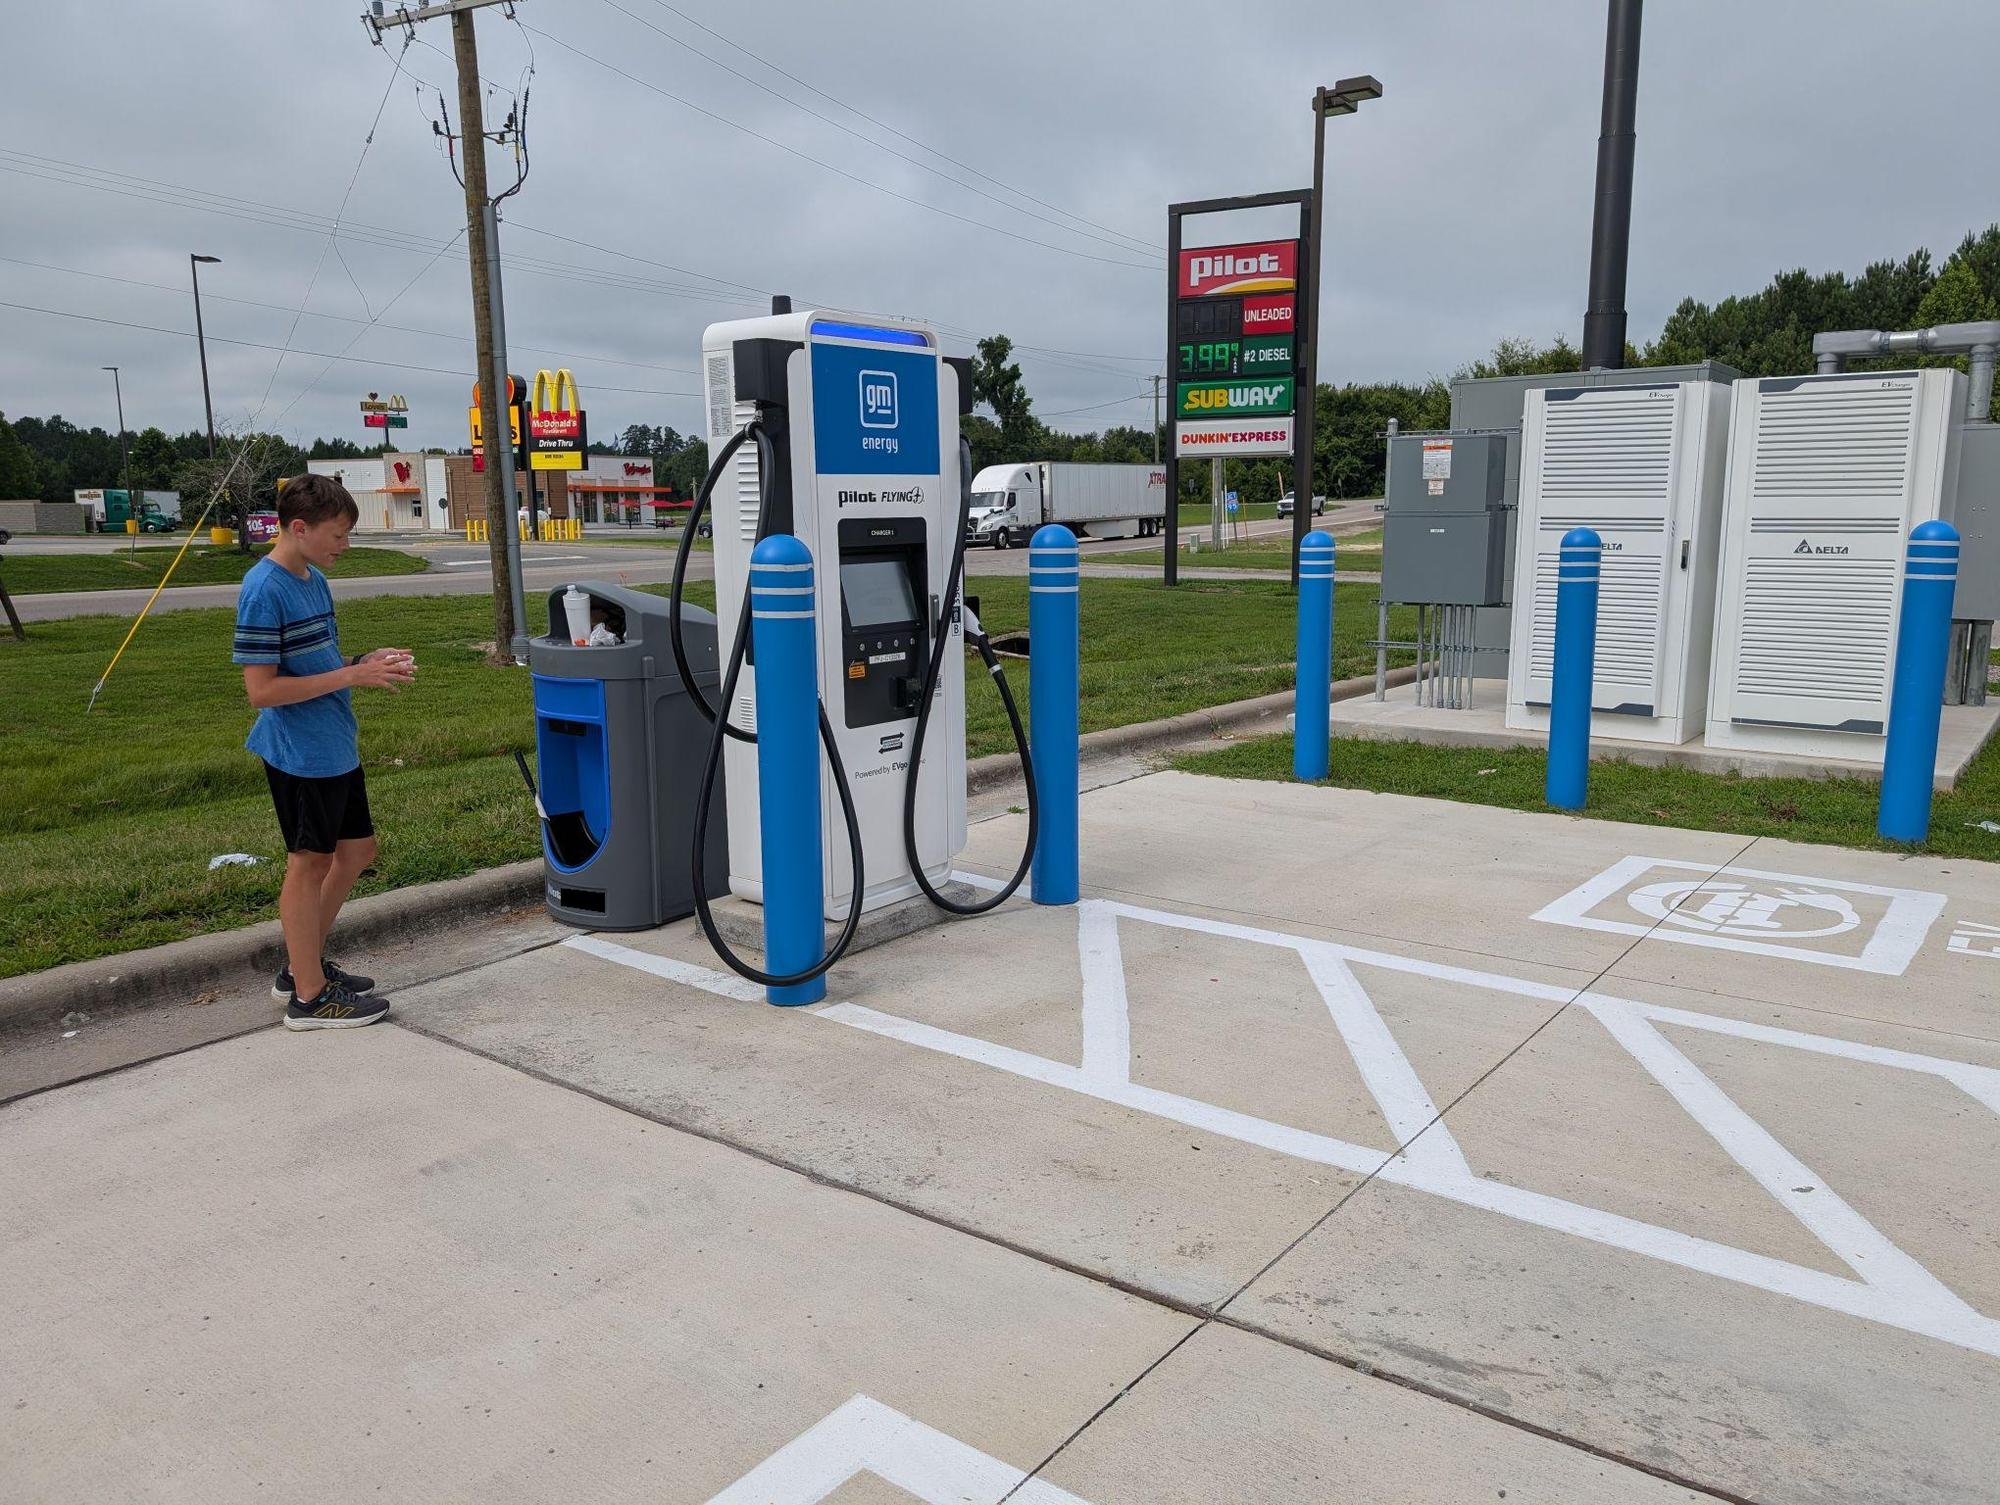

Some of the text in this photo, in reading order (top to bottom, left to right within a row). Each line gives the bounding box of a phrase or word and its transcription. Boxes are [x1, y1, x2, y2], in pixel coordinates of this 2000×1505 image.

[1244, 306, 1292, 323] UNLEADED
[1243, 347, 1291, 362] #2 DIESEL
[865, 384, 892, 414] gm
[1183, 384, 1286, 410] SUBWAY
[531, 419, 577, 428] McDonald's
[539, 439, 574, 448] Drive Thru
[862, 437, 898, 454] energy
[880, 491, 914, 503] FLYING
[1601, 543, 1623, 551] ELTA
[1815, 545, 1849, 555] DELTA
[855, 762, 909, 779] Powered by EVgo
